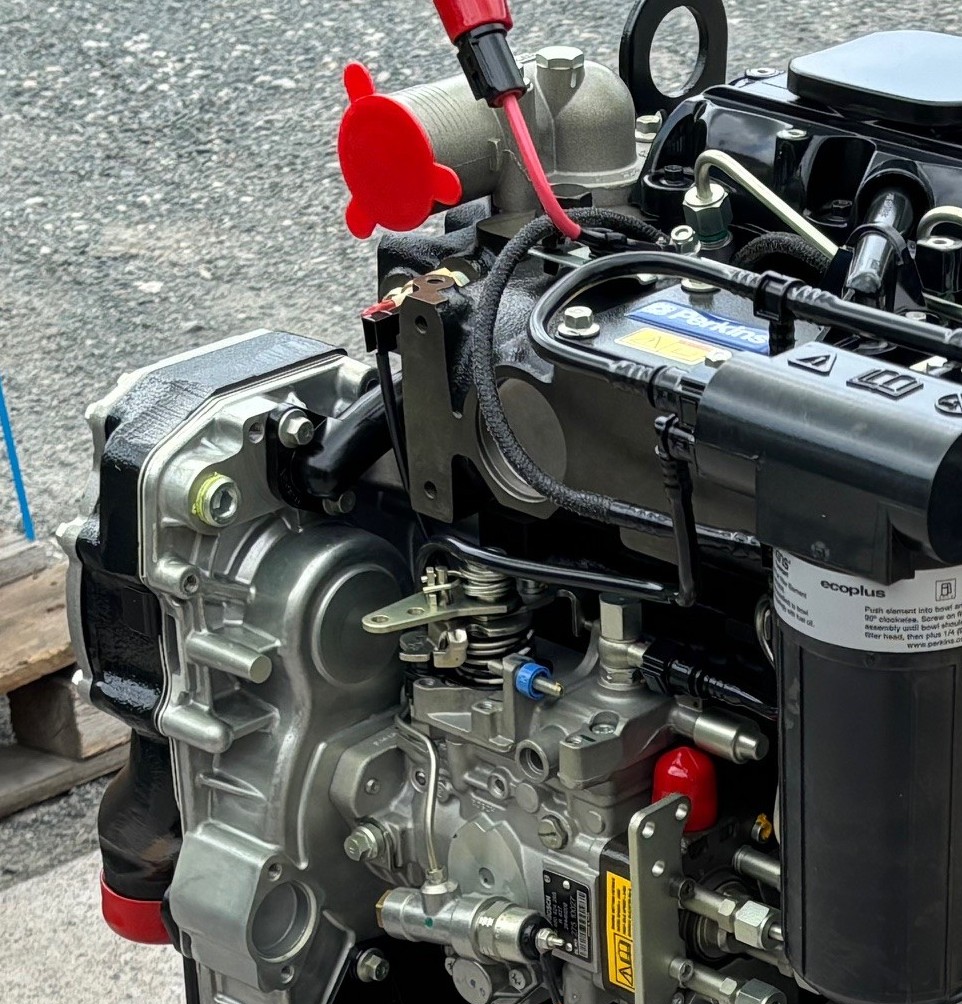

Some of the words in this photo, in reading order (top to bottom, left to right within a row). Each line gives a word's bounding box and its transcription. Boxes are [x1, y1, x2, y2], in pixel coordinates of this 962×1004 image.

[668, 307, 768, 344] Perkins
[820, 580, 886, 598] ecoplus
[864, 605, 884, 614] Push
[885, 607, 917, 615] element
[934, 604, 953, 613] bowl
[921, 615, 944, 623] Screw
[864, 624, 901, 633] assembly
[902, 623, 920, 632] until
[920, 623, 940, 632] bowl
[864, 631, 882, 640] filter
[925, 631, 942, 640] plus
[943, 629, 955, 638] 1/4
